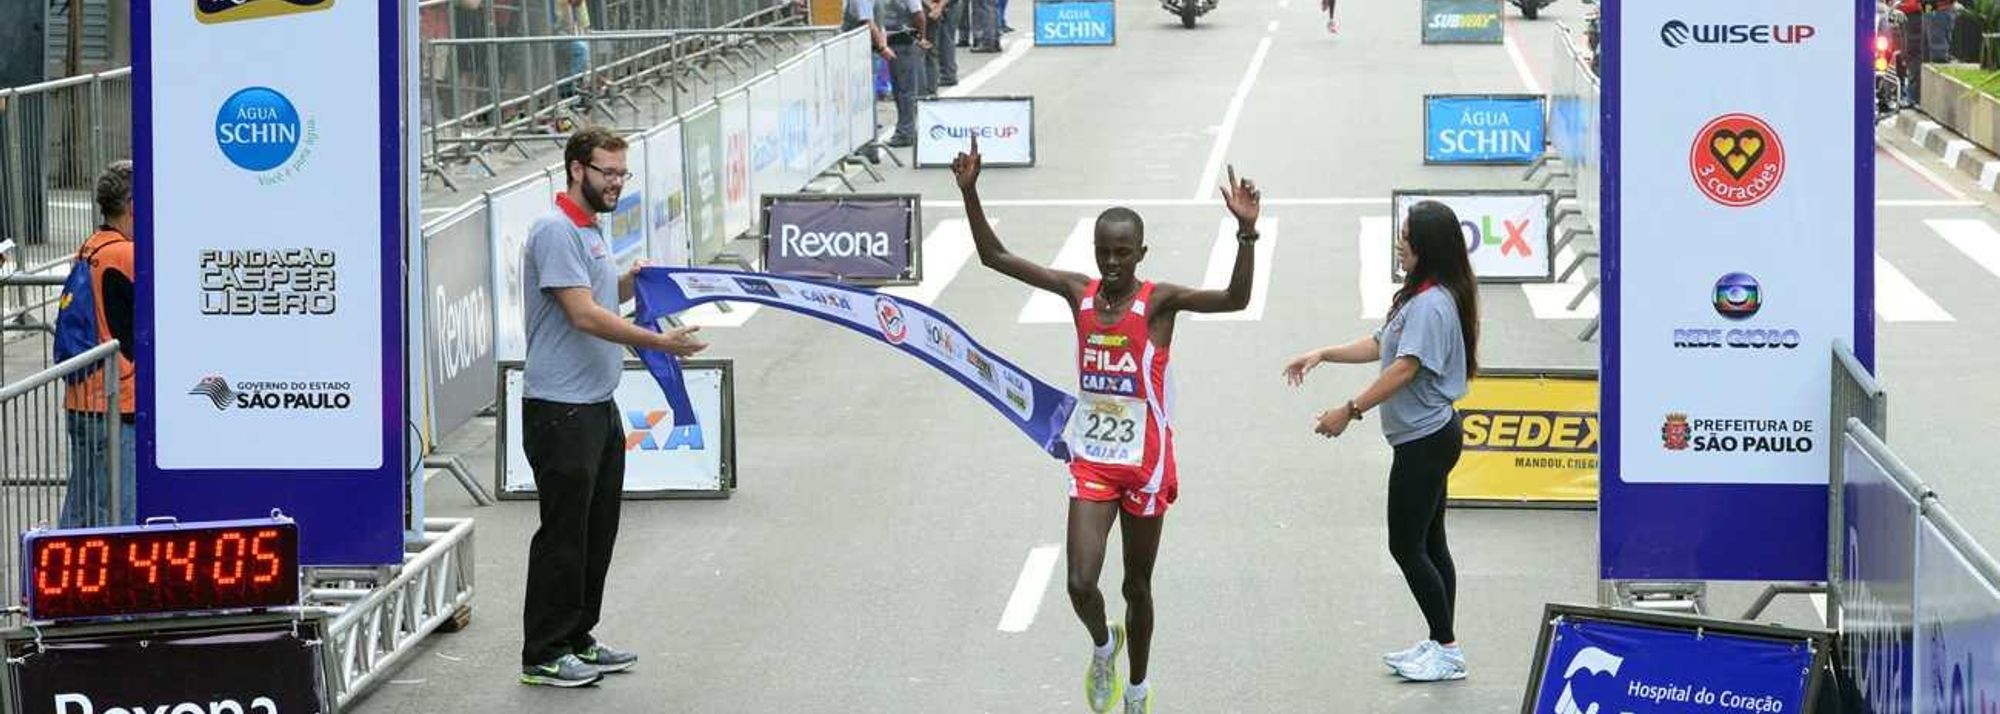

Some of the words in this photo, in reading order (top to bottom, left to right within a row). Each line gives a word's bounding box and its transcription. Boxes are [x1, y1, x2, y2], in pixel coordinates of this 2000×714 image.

[1044, 22, 1106, 38] SCHIN
[1428, 13, 1497, 28] SUBWAY
[1692, 25, 1769, 43] WISE
[1773, 25, 1815, 43] UP
[236, 105, 278, 120] ÁGUA
[1459, 108, 1509, 126] ÁGUA
[219, 122, 296, 145] SCHIN
[947, 126, 992, 138] WISE
[994, 126, 1019, 138] UP
[1439, 129, 1531, 154] SCHIN
[1699, 163, 1715, 176] 3
[781, 223, 888, 257] Rexona
[436, 283, 487, 385] Rexona
[1673, 329, 1723, 348] REDE
[1726, 329, 1801, 349] GLOBO
[1083, 347, 1138, 373] FILA
[236, 381, 288, 391] GOVERNO
[290, 381, 306, 391] DO
[309, 381, 350, 391] ESTADO
[1082, 374, 1134, 393] CAIXA
[236, 390, 280, 410] SÃO
[283, 392, 351, 409] PAULO
[1084, 413, 1136, 443] 223
[1462, 413, 1598, 449] SEDEX
[1694, 419, 1788, 431] PREFEITURA
[1793, 420, 1813, 432] DE
[1693, 433, 1738, 451] SÃO
[1743, 436, 1813, 452] PAULO
[39, 541, 109, 594] 00
[129, 540, 196, 583] 44
[213, 531, 279, 584] 05
[1627, 680, 1693, 703] Hospital
[1695, 687, 1715, 705] do
[1719, 689, 1783, 714] Coração
